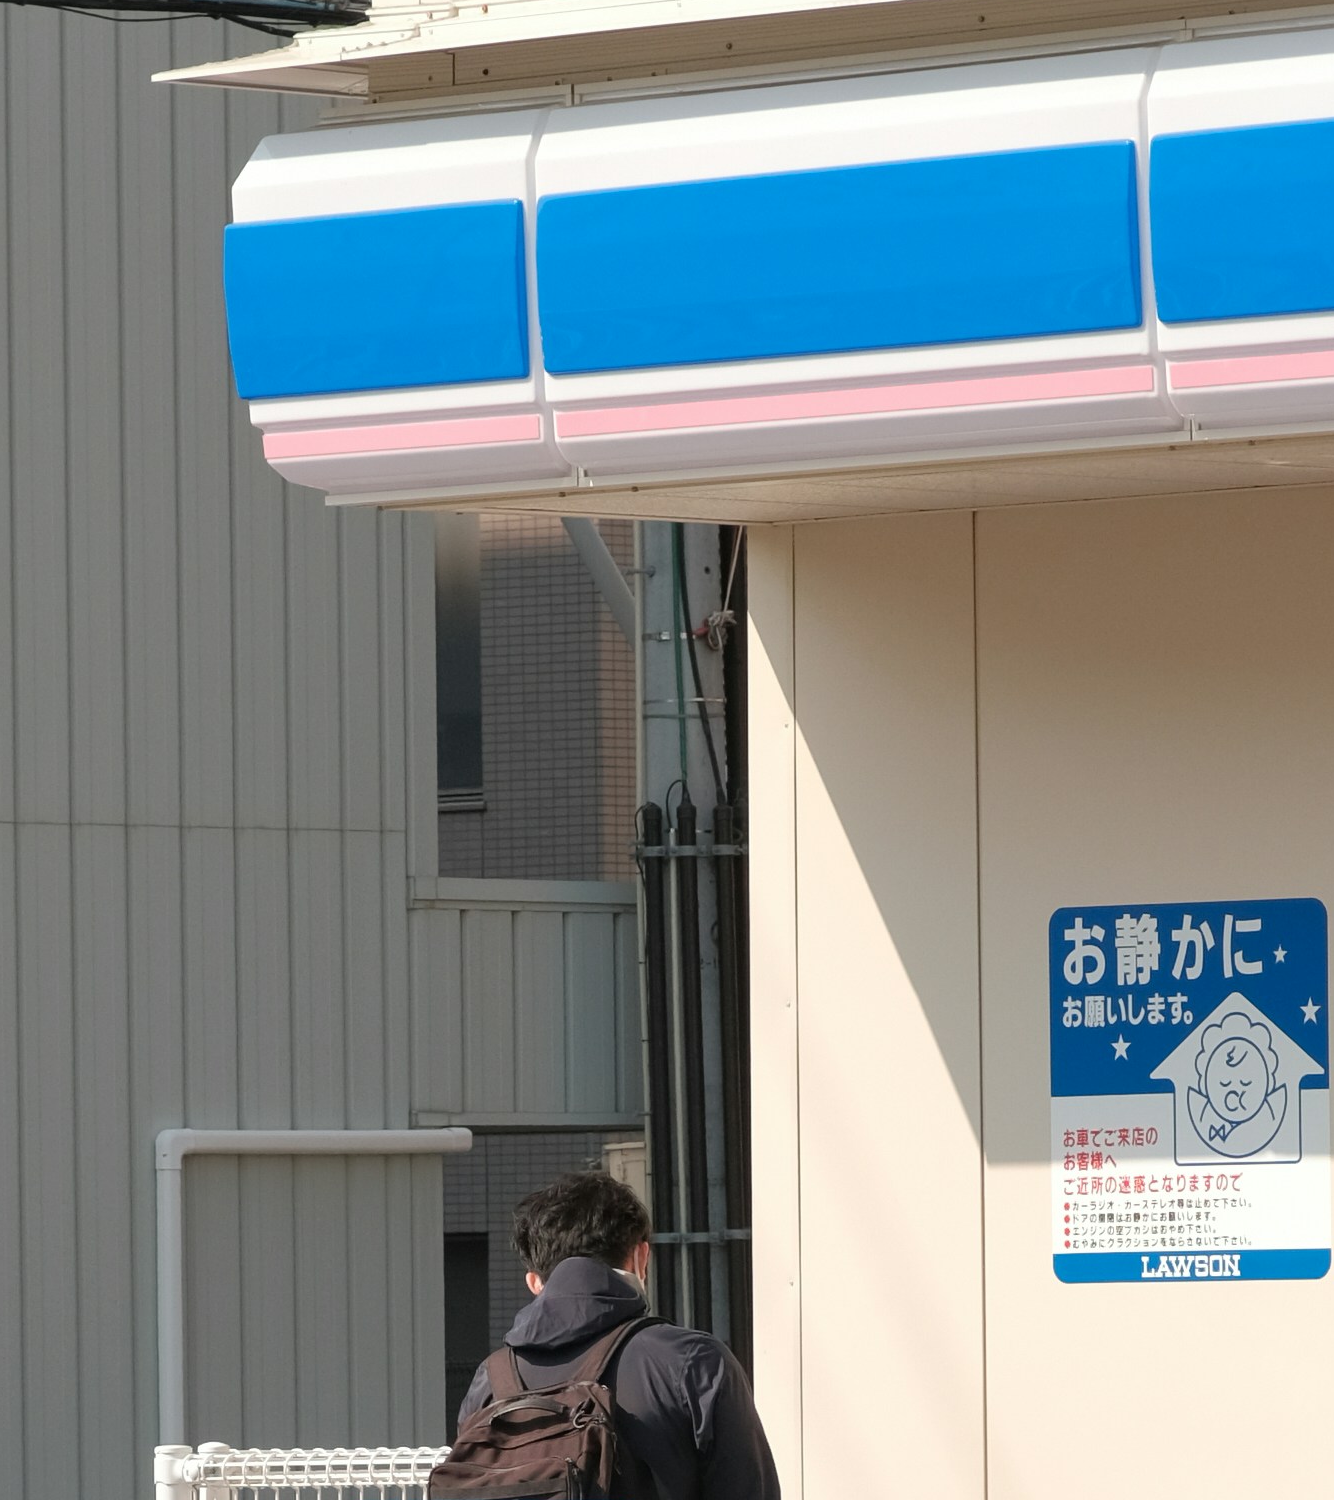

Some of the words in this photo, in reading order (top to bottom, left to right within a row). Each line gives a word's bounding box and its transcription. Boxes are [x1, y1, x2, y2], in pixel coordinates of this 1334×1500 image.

[1062, 912, 1264, 986] お静かに
[1061, 991, 1195, 1029] お願いします。
[1063, 1126, 1159, 1148] お車でご来店の
[1063, 1151, 1117, 1171] お客様へ
[1063, 1172, 1244, 1196] ご近所の迷惑となりますので
[1140, 1254, 1242, 1278] LAWSON
